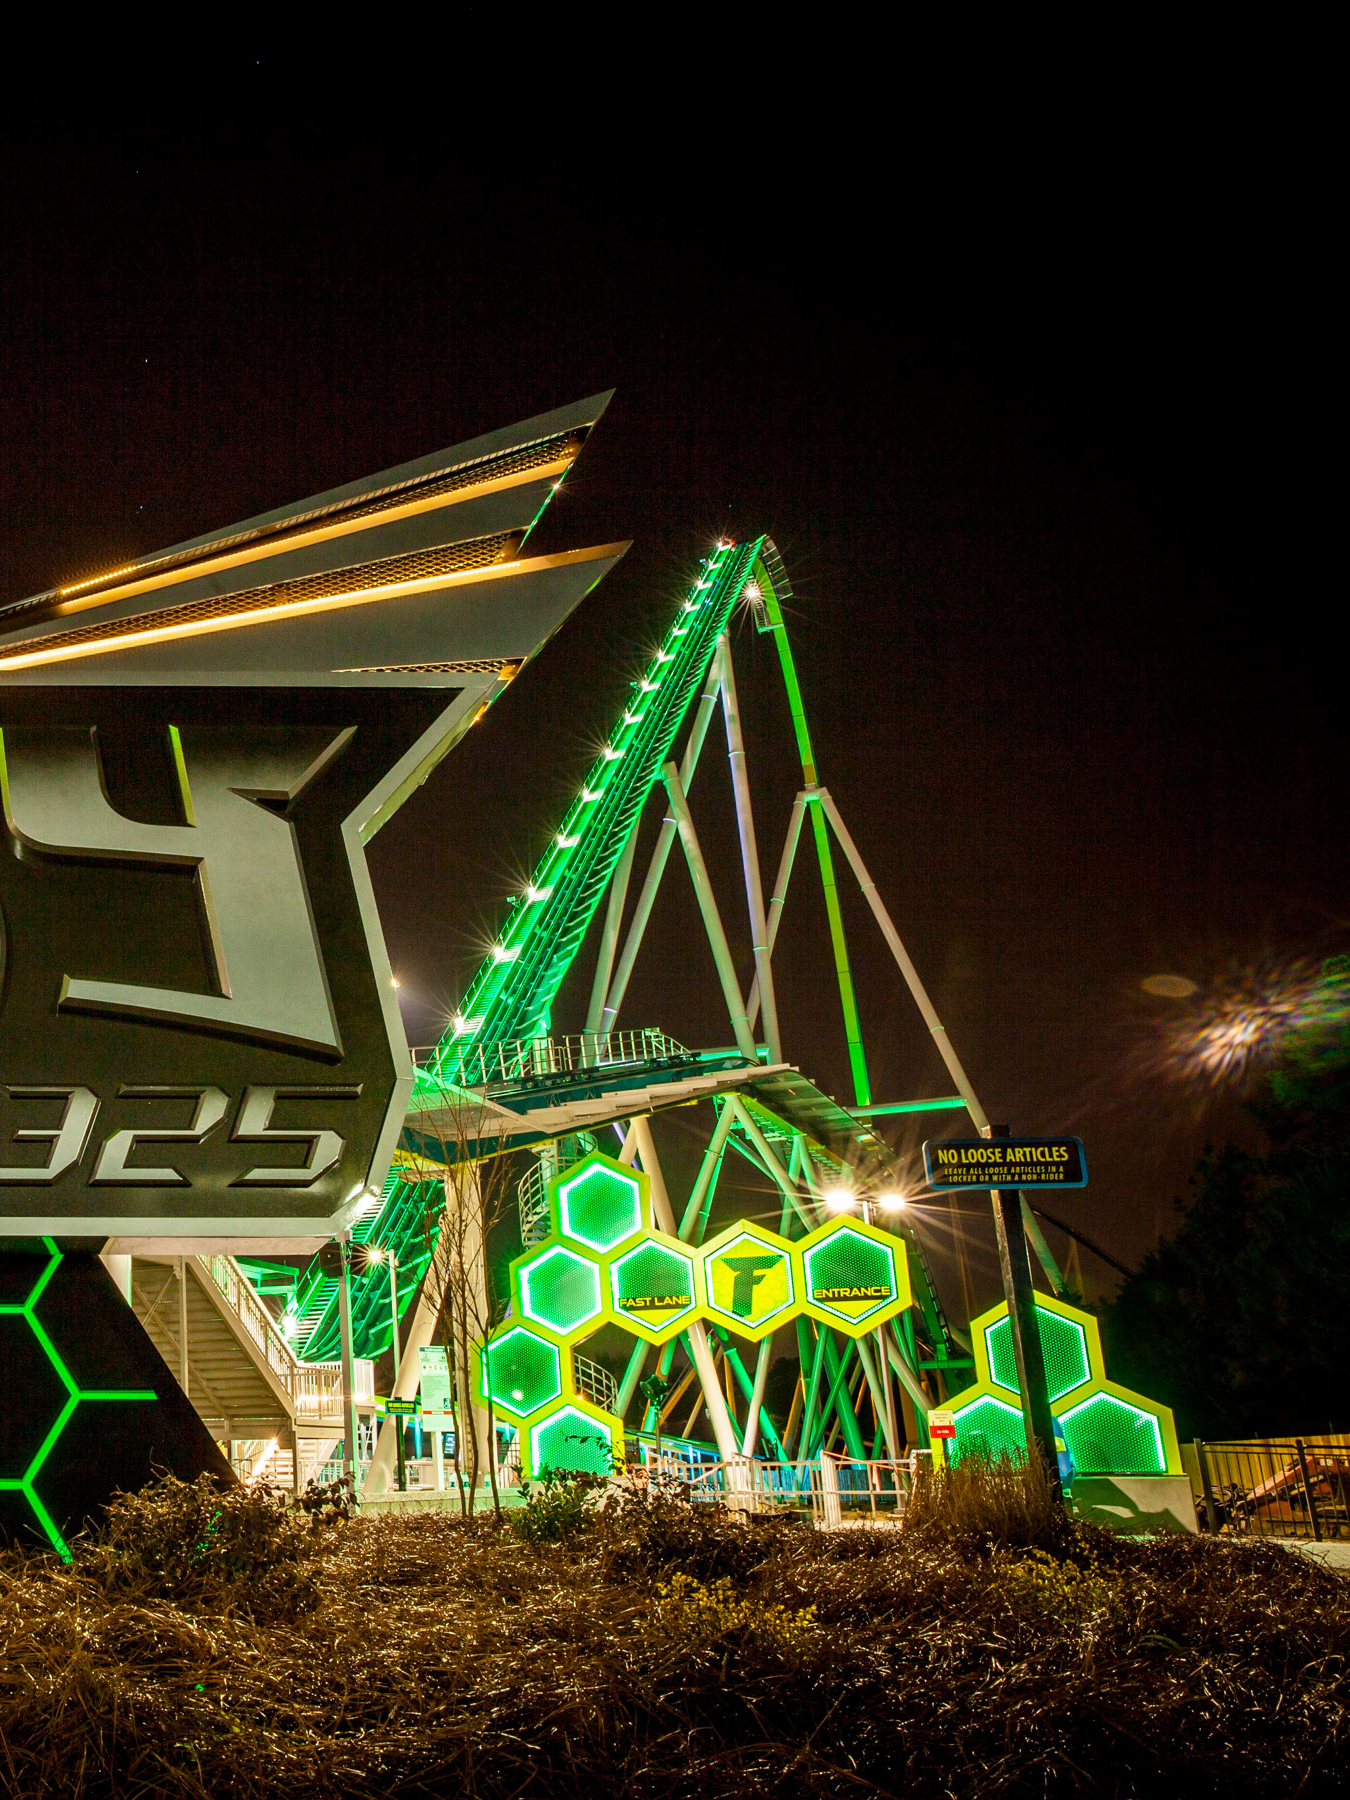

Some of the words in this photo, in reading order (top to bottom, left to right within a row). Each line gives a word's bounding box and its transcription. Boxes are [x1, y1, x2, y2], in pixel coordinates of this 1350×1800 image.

[937, 1149, 958, 1164] NO
[960, 1148, 1003, 1163] LOOSE
[1006, 1146, 1069, 1162] ARTICLES
[944, 1167, 967, 1175] LEAVE
[985, 1166, 1008, 1174] LOOSE
[949, 1174, 977, 1182] LOCKER
[1021, 1173, 1064, 1181] NON-RIDER
[720, 1254, 785, 1318] F
[813, 1286, 891, 1298] ENTRANCE
[619, 1297, 652, 1307] FAST
[654, 1295, 691, 1306] LANE
